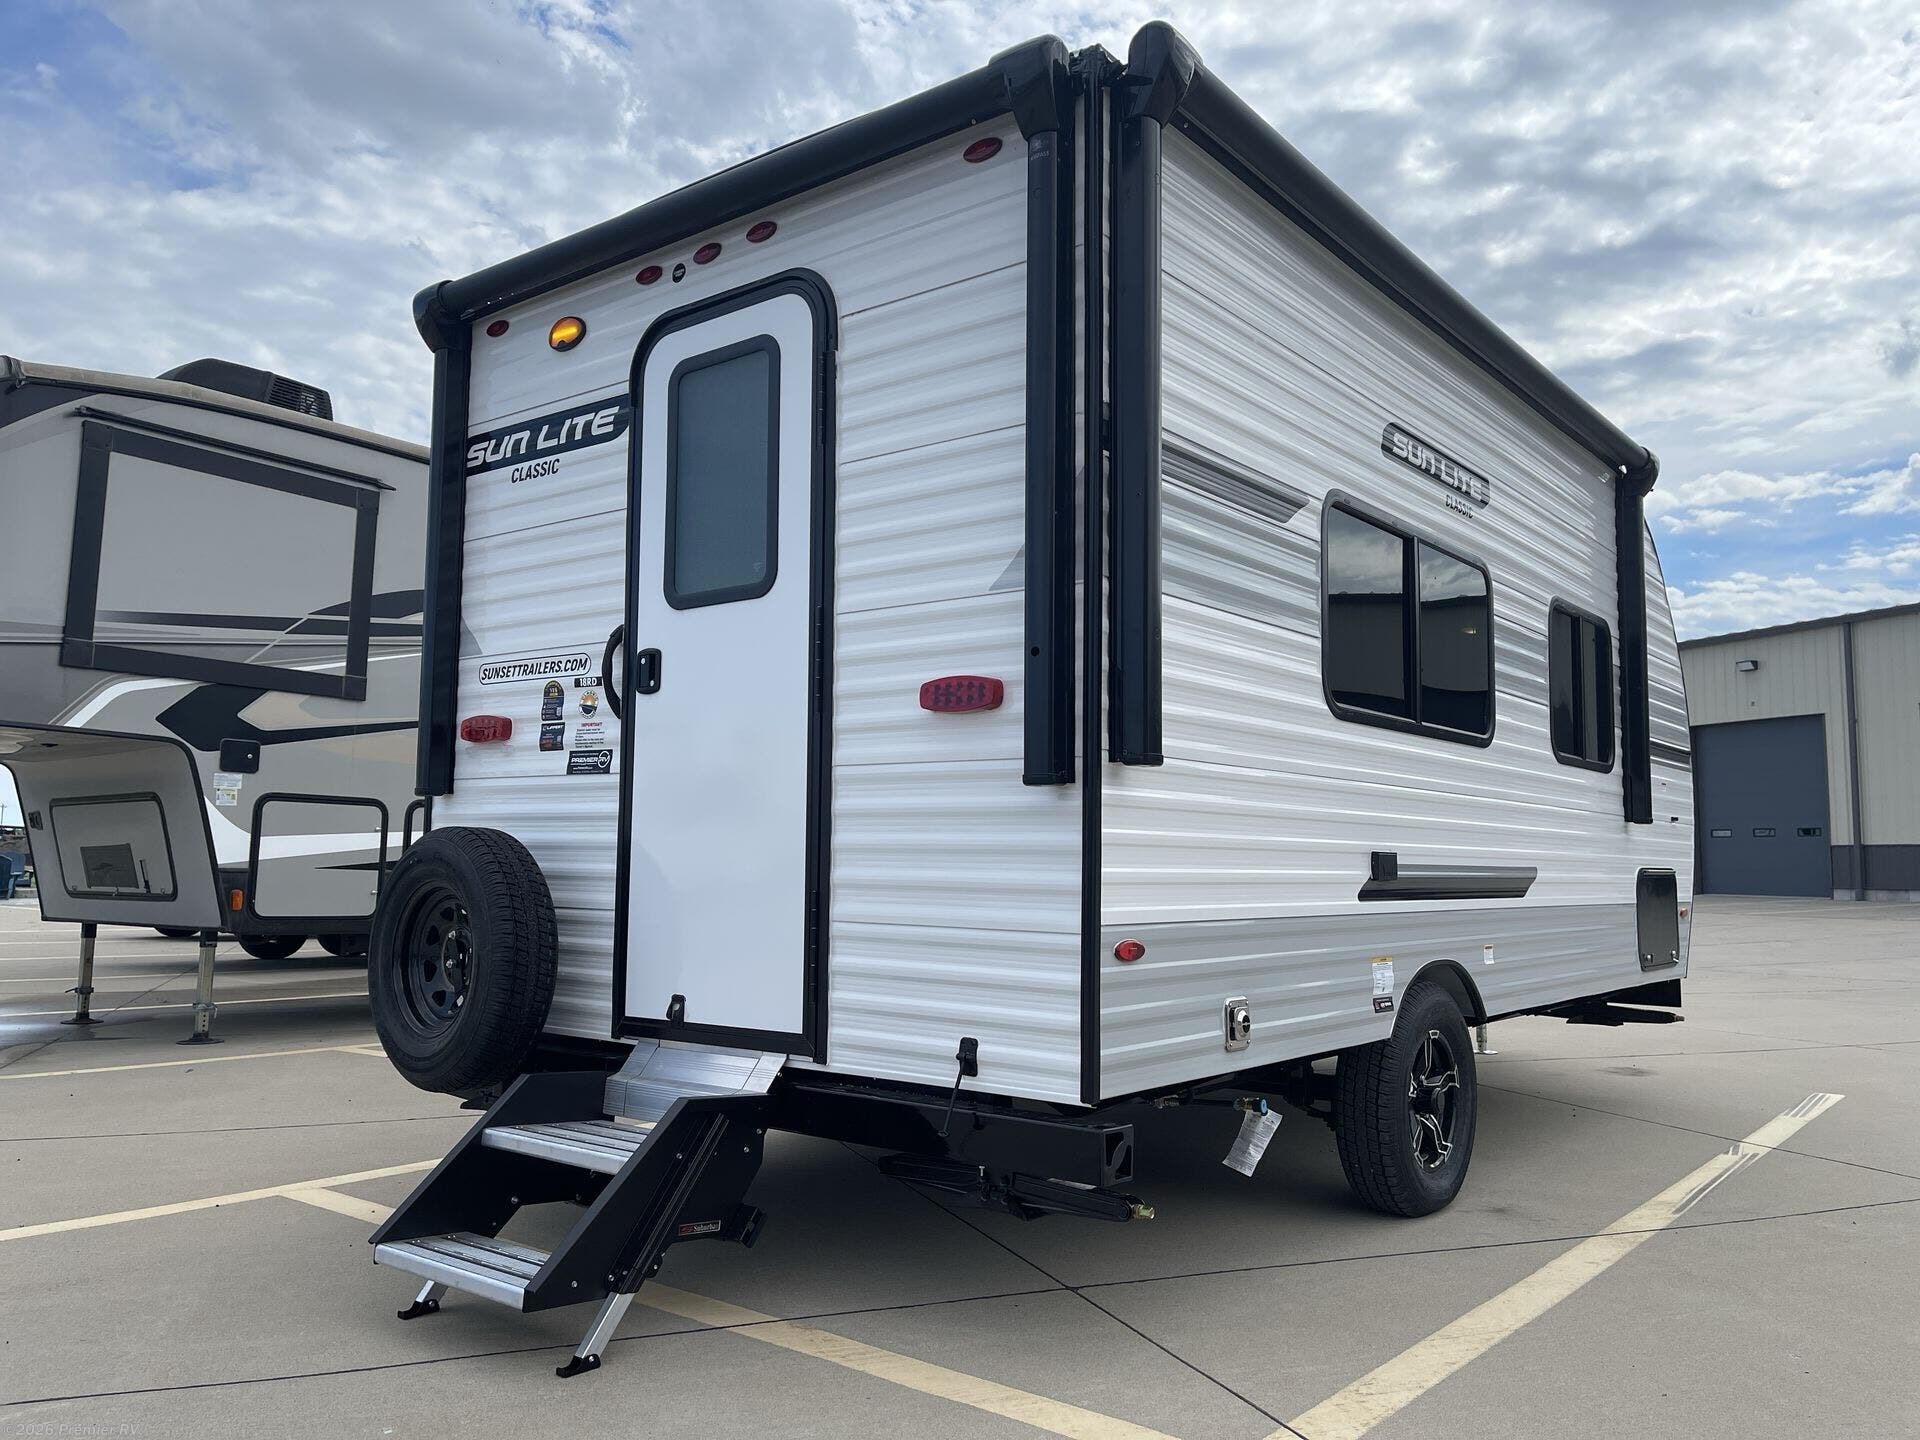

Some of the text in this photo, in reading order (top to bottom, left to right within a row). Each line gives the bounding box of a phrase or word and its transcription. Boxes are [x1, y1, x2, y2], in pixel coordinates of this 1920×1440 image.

[466, 405, 620, 468] SUN LITE
[511, 458, 561, 484] CLASSIC
[1392, 432, 1483, 502] SUN LITE
[1445, 494, 1474, 519] CLASSIC
[481, 657, 588, 681] SUNSETTRAILERS.COM
[579, 677, 598, 687] 18RD
